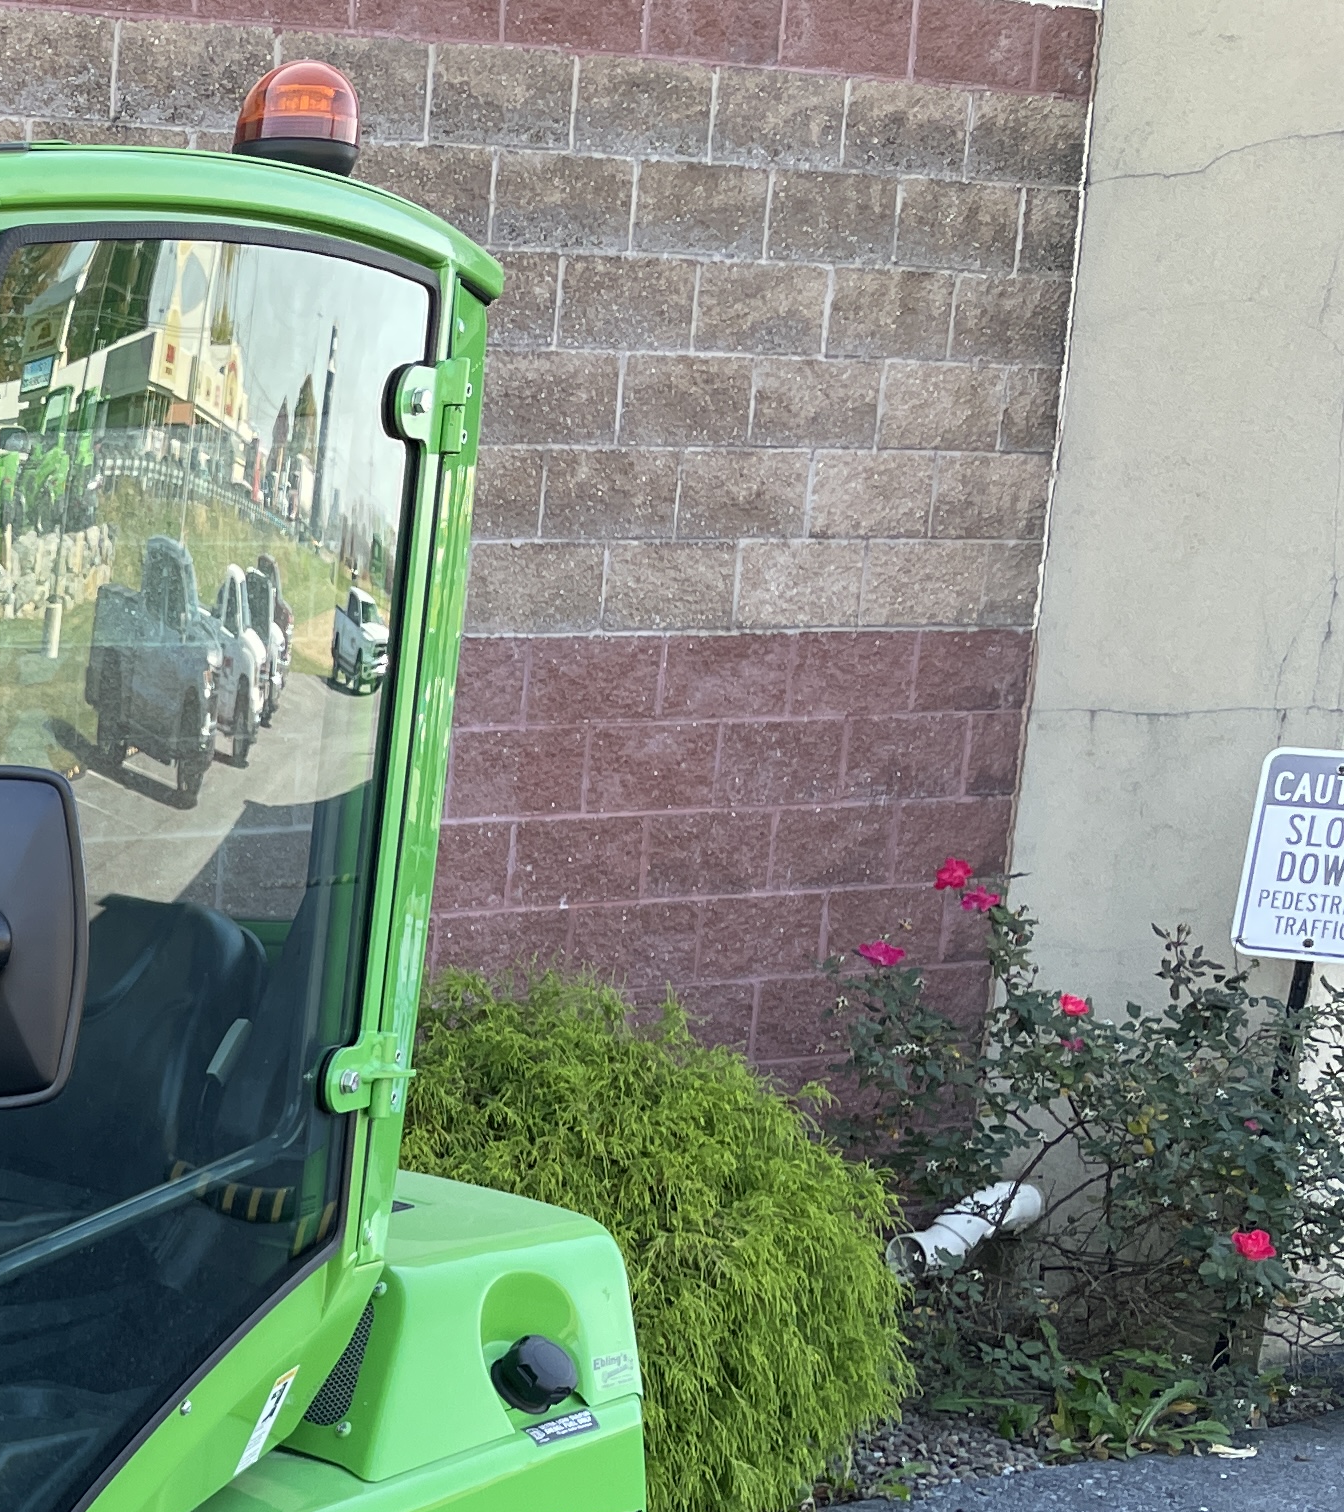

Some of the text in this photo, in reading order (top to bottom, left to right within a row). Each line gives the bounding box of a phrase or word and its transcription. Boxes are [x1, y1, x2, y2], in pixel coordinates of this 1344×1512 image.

[1285, 814, 1344, 848] SLO
[1276, 851, 1344, 887] DOW
[1257, 889, 1344, 915] PEDESTR
